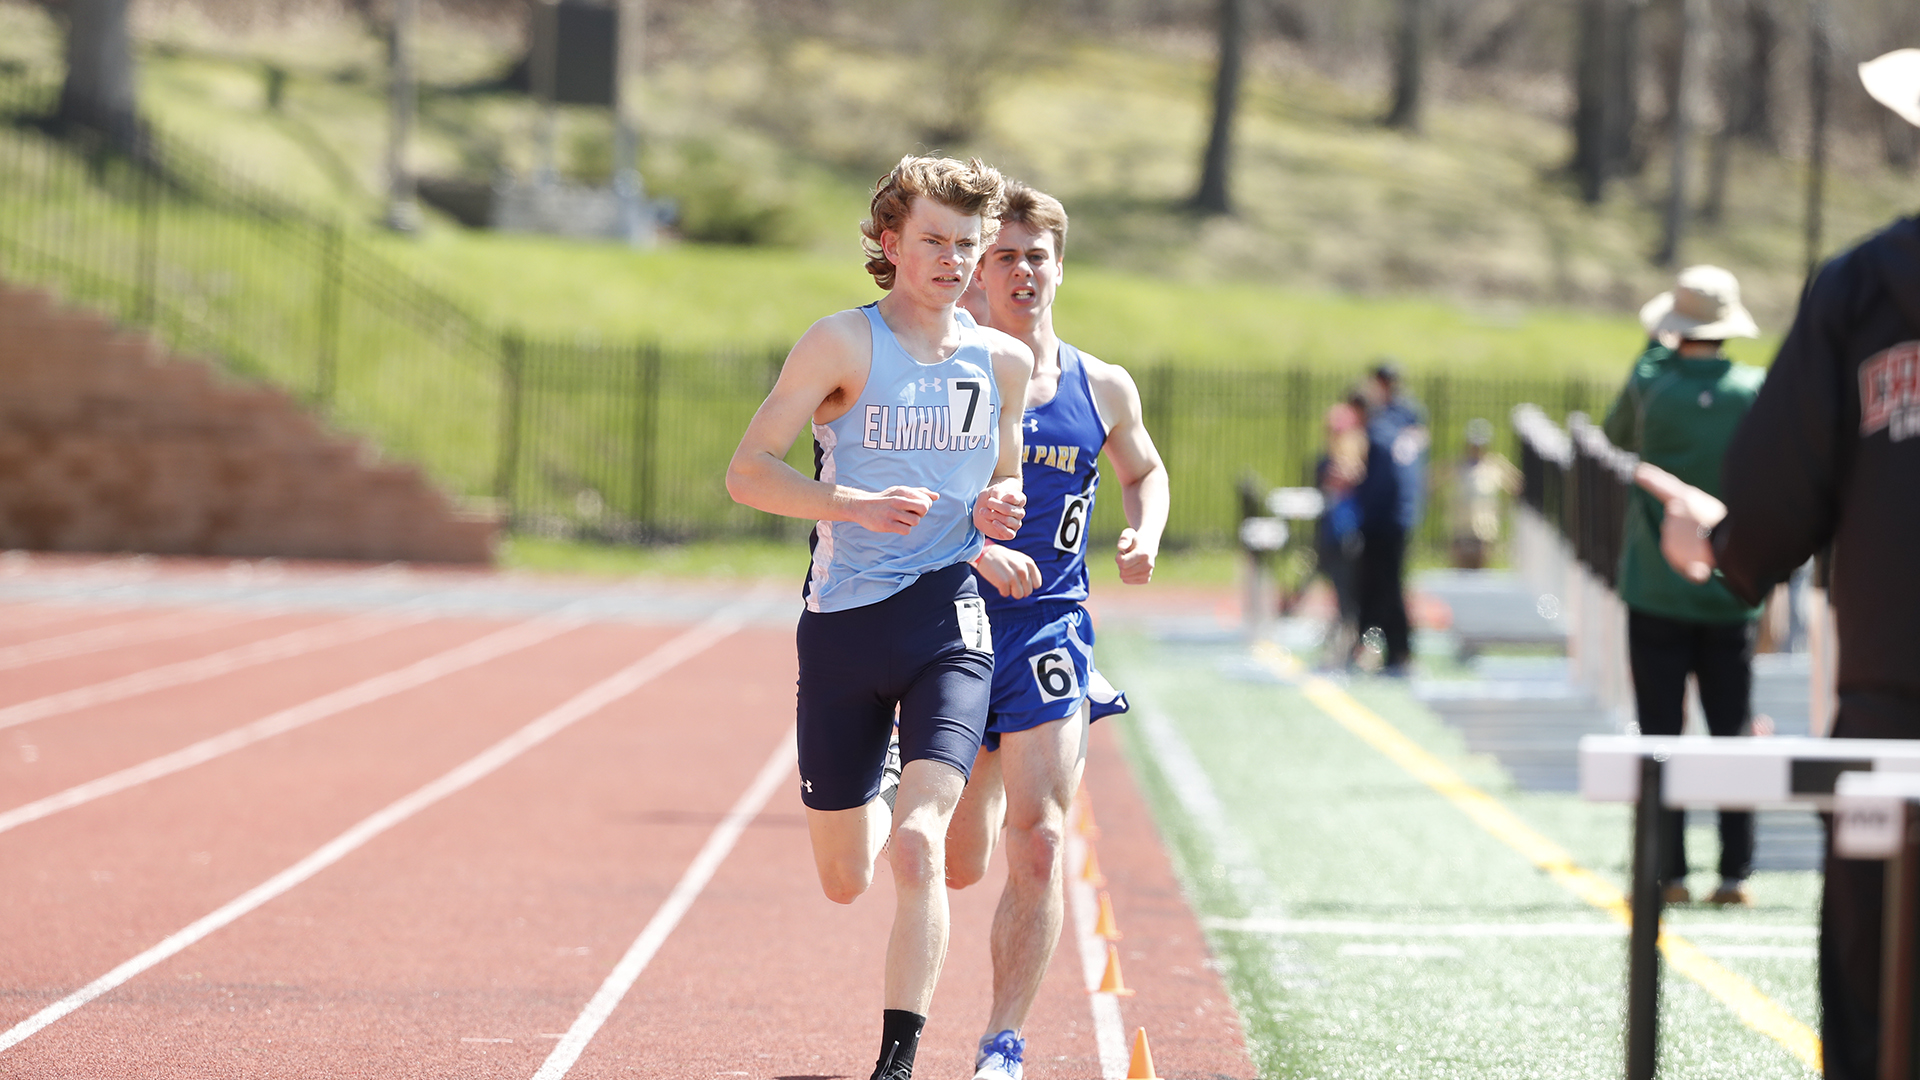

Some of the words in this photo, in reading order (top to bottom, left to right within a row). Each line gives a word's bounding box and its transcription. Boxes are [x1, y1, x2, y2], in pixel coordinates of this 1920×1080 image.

[956, 382, 981, 433] 7
[1033, 445, 1080, 474] PARK
[1060, 499, 1083, 549] 6
[1037, 653, 1071, 697] 6
